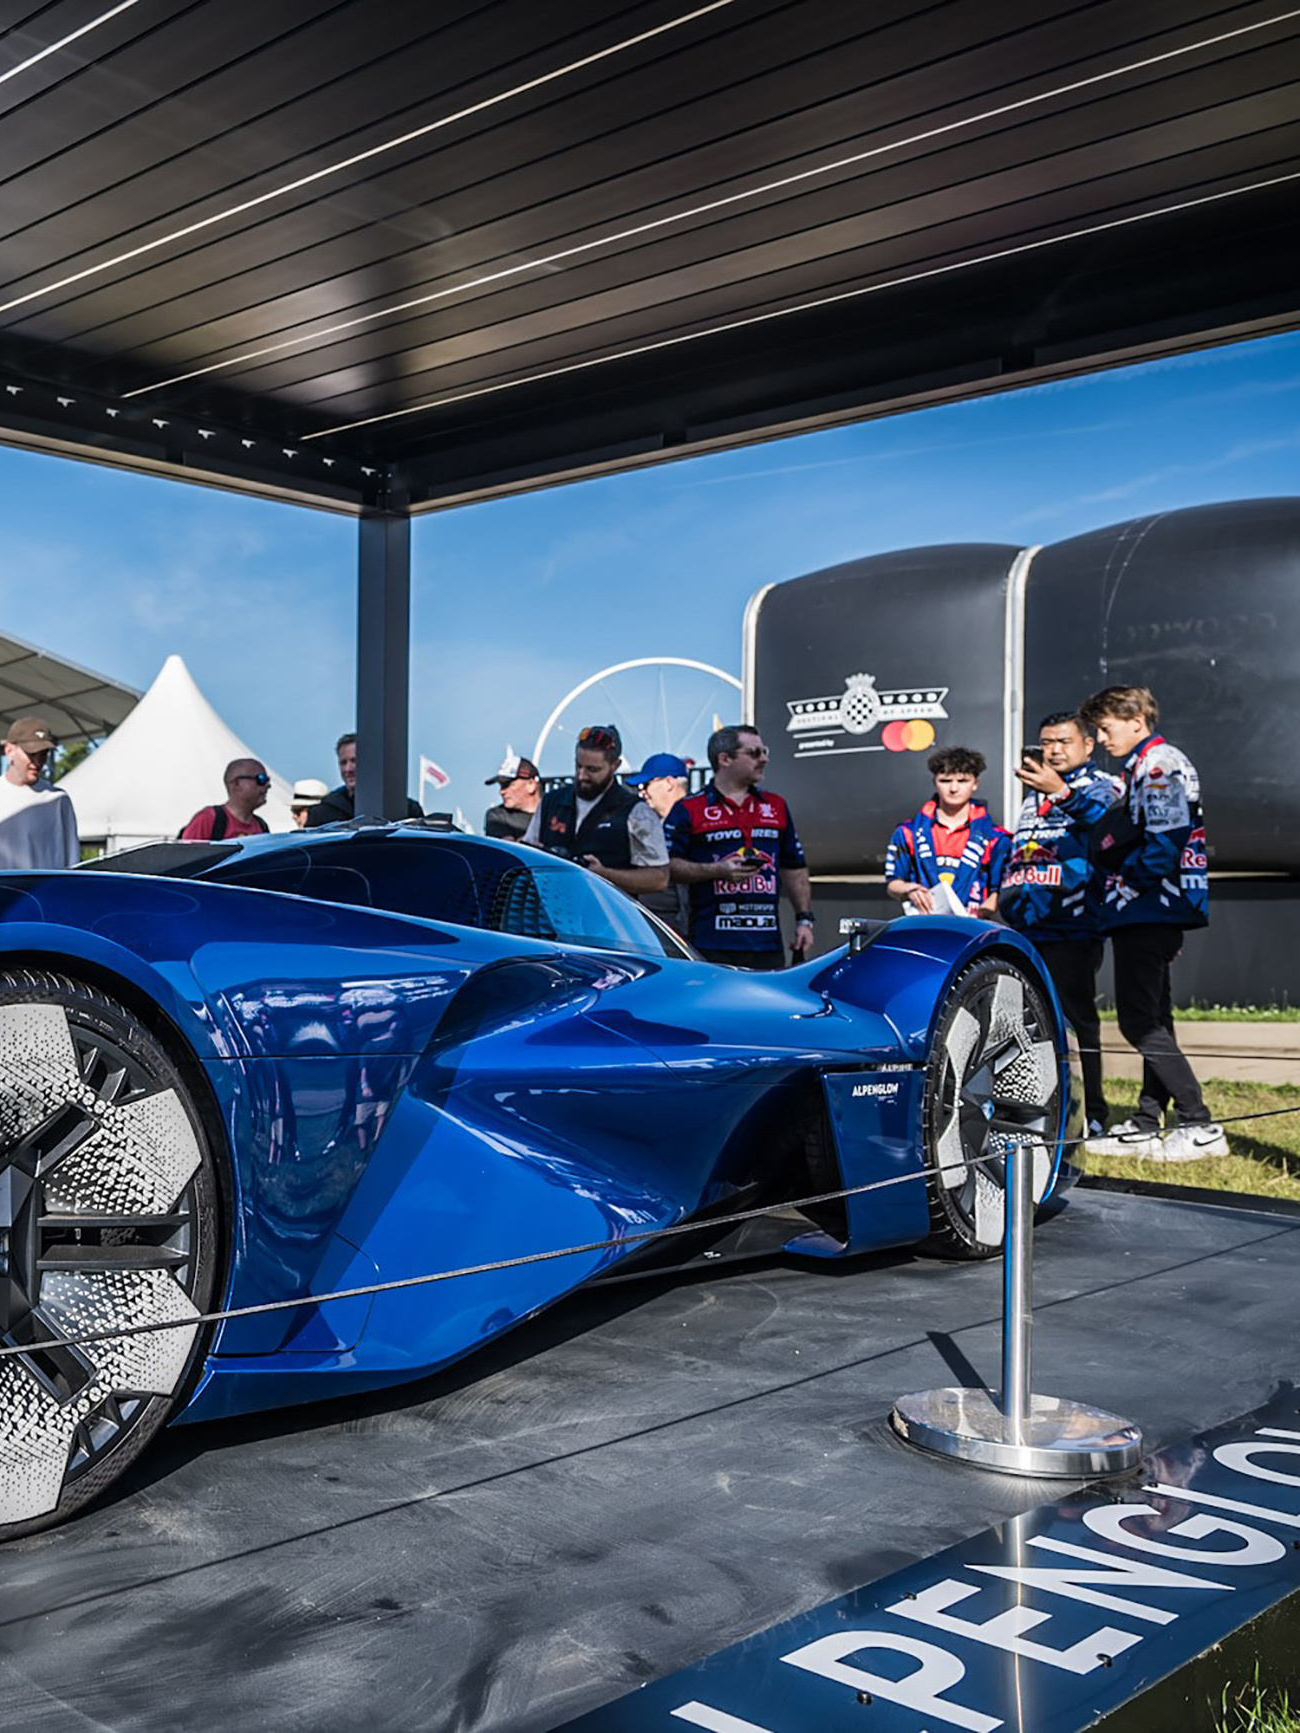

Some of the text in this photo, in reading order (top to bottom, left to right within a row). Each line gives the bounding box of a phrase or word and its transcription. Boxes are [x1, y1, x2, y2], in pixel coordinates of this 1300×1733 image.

[706, 829, 742, 842] TOYO
[1025, 865, 1061, 885] Bull
[852, 1083, 899, 1097] ALPENGLOW
